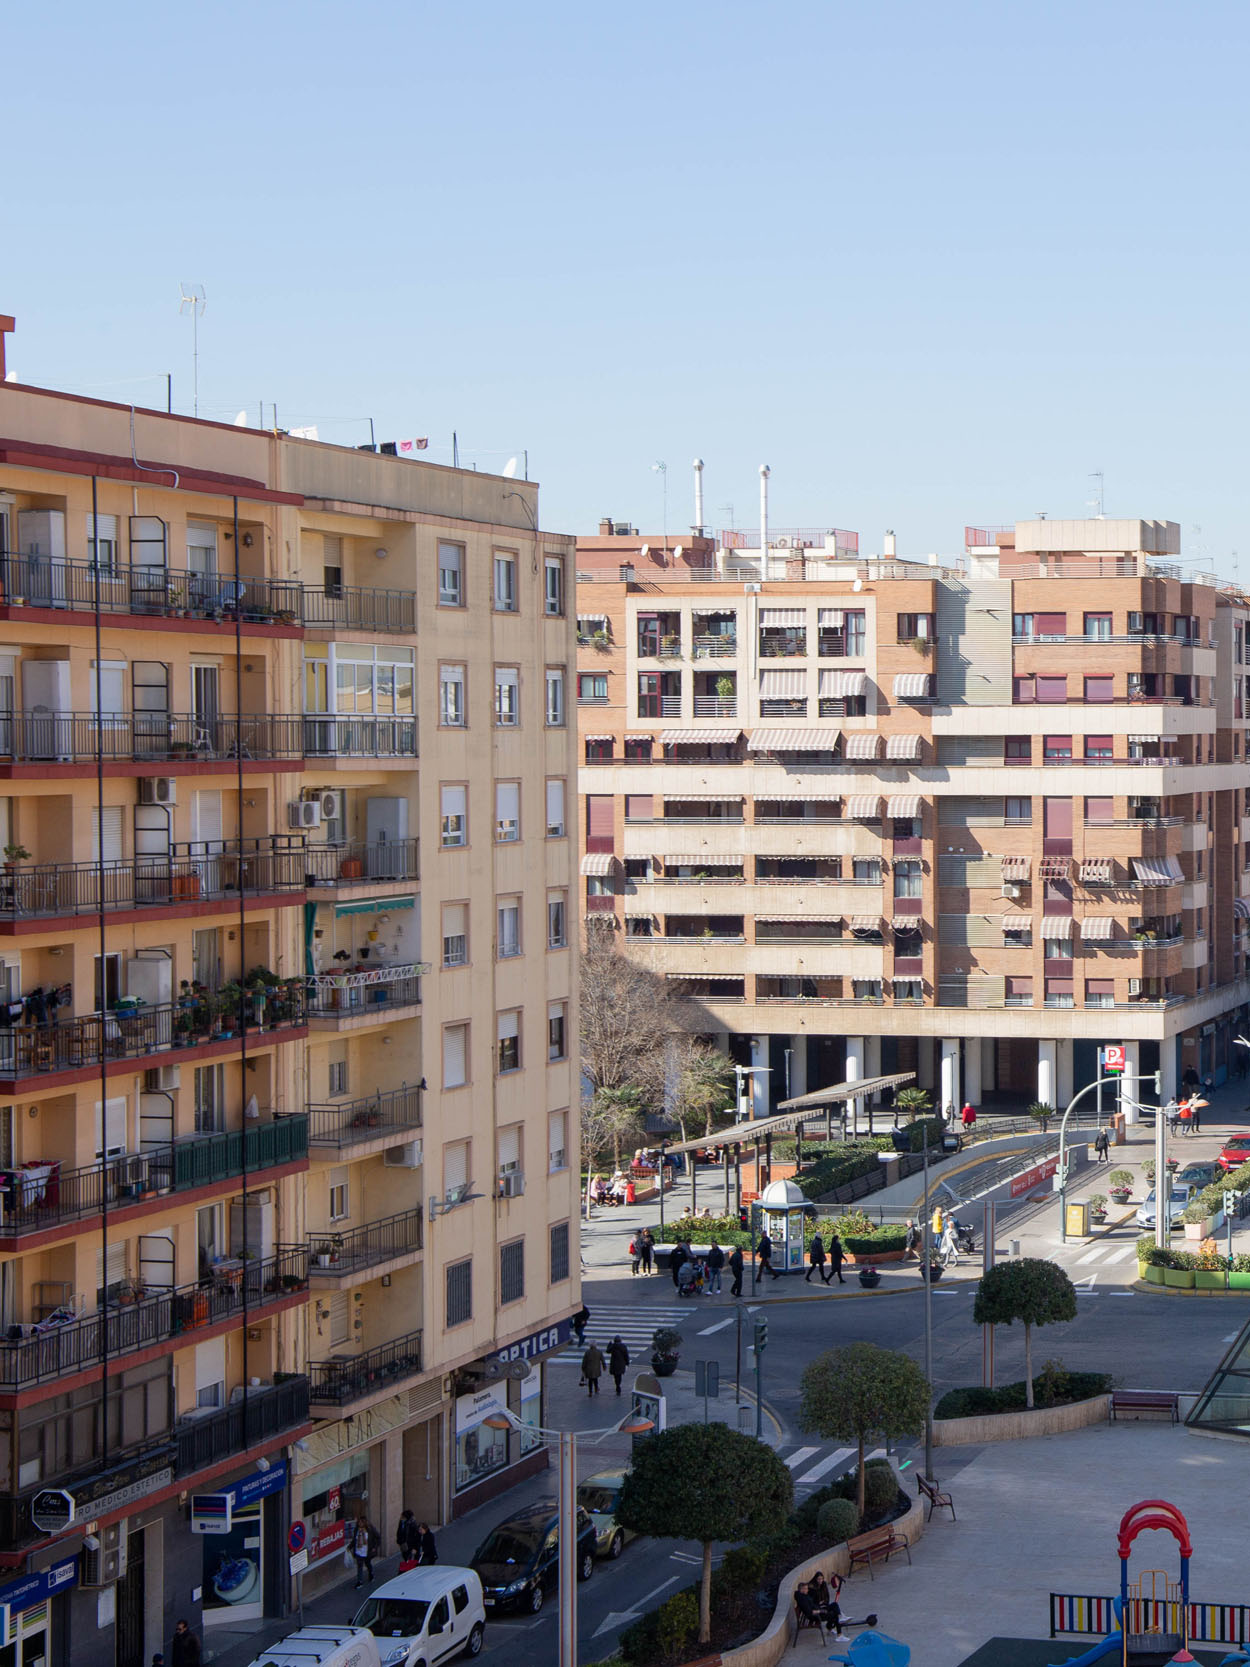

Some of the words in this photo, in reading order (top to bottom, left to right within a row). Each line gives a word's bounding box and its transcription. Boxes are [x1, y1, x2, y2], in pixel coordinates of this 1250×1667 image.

[499, 1327, 559, 1363] OPTICA
[319, 1529, 344, 1547] REBAJAS
[57, 1565, 74, 1578] isaval
